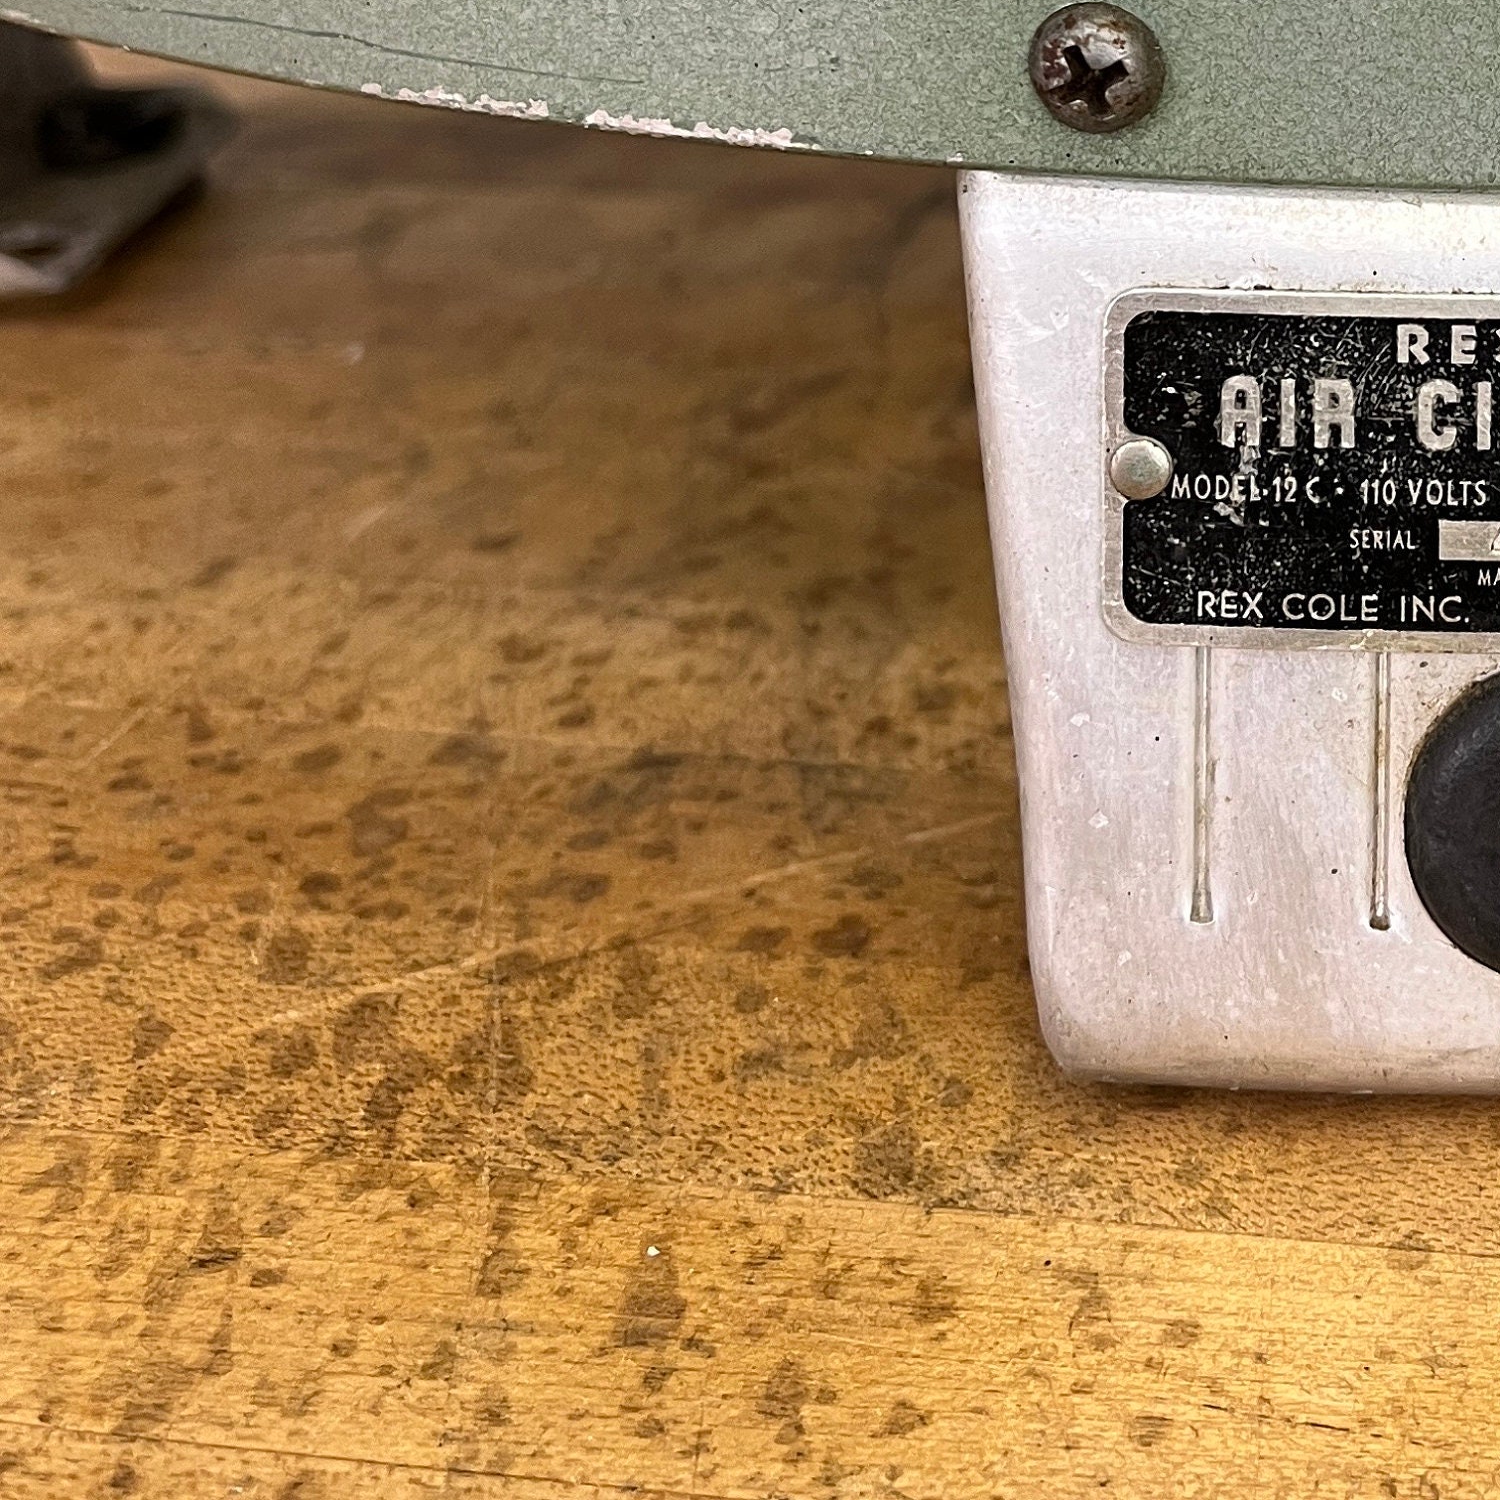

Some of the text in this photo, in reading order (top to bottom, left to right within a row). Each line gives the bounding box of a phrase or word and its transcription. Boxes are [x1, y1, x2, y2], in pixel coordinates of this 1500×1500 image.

[1218, 374, 1356, 450] AIR
[1170, 473, 1261, 502] MODEL
[1361, 479, 1397, 505] 110
[1408, 479, 1487, 506] VOLTS
[1349, 528, 1416, 550] SERIAL
[1197, 590, 1264, 619] REX
[1282, 592, 1379, 622] COLE
[1400, 596, 1470, 623] INC.
